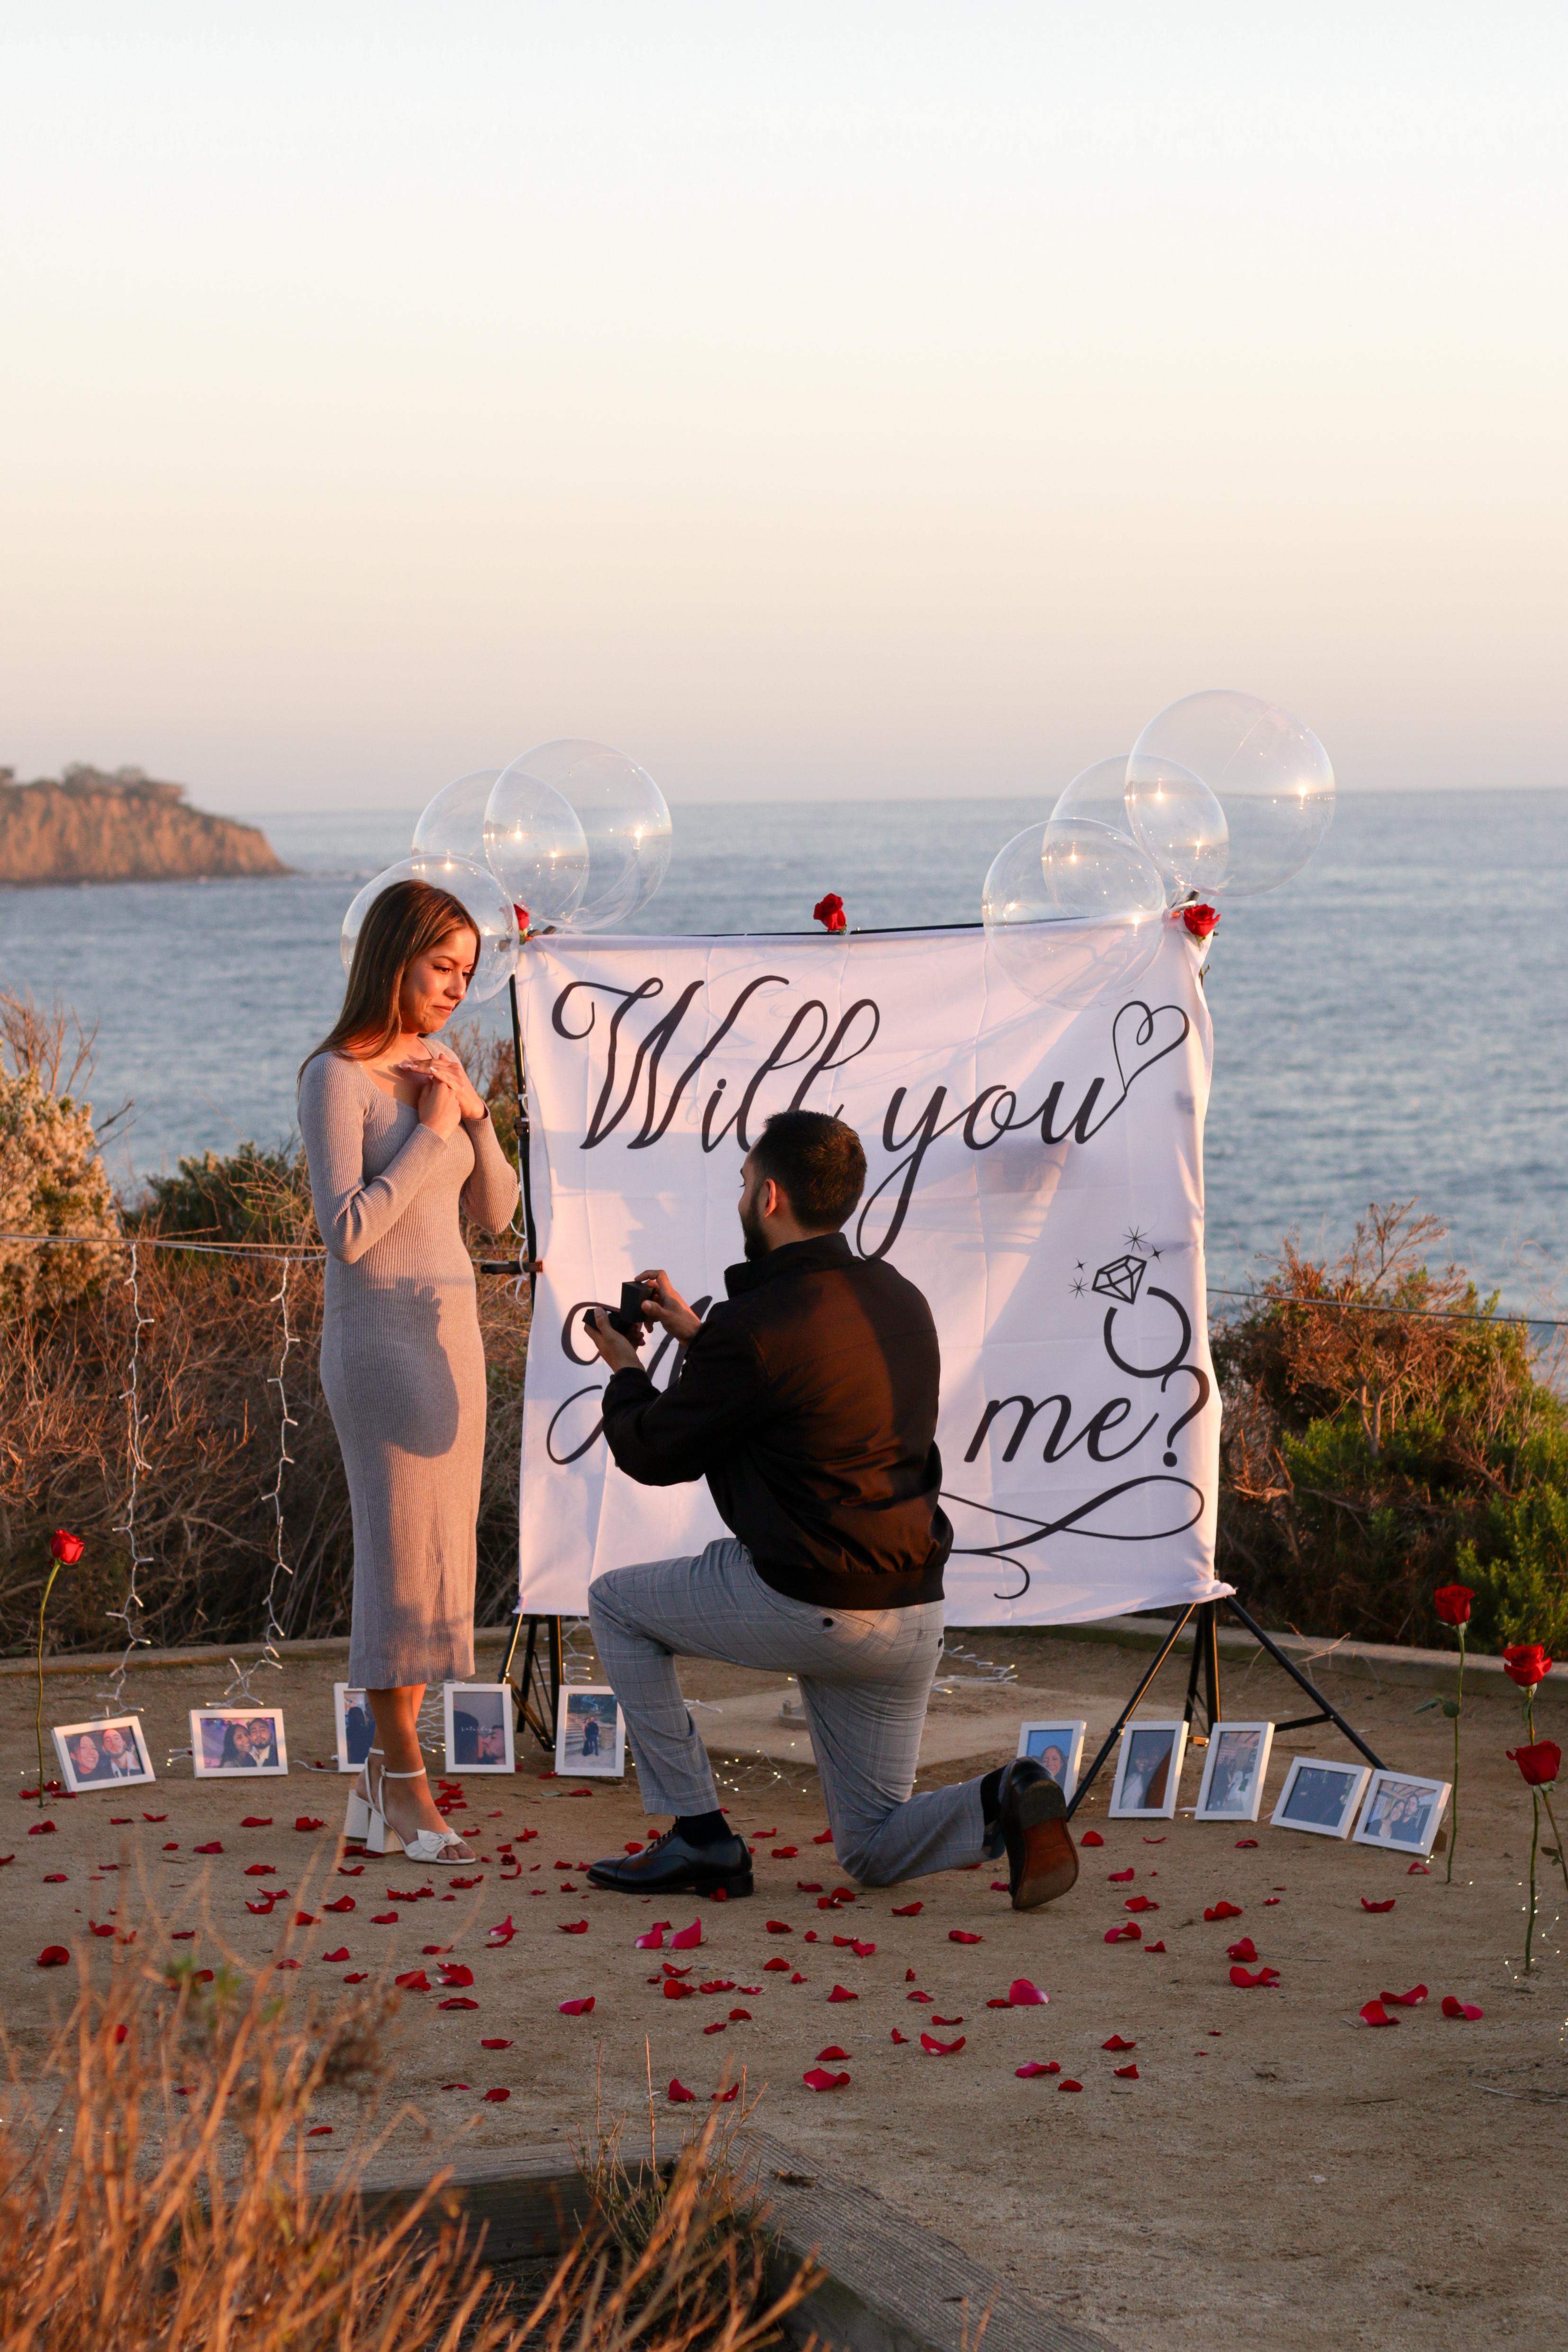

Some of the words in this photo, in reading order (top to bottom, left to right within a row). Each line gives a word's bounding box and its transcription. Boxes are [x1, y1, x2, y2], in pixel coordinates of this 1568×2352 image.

[551, 974, 880, 1153] Will
[856, 1077, 1126, 1260] you
[964, 1364, 1210, 1468] me?
